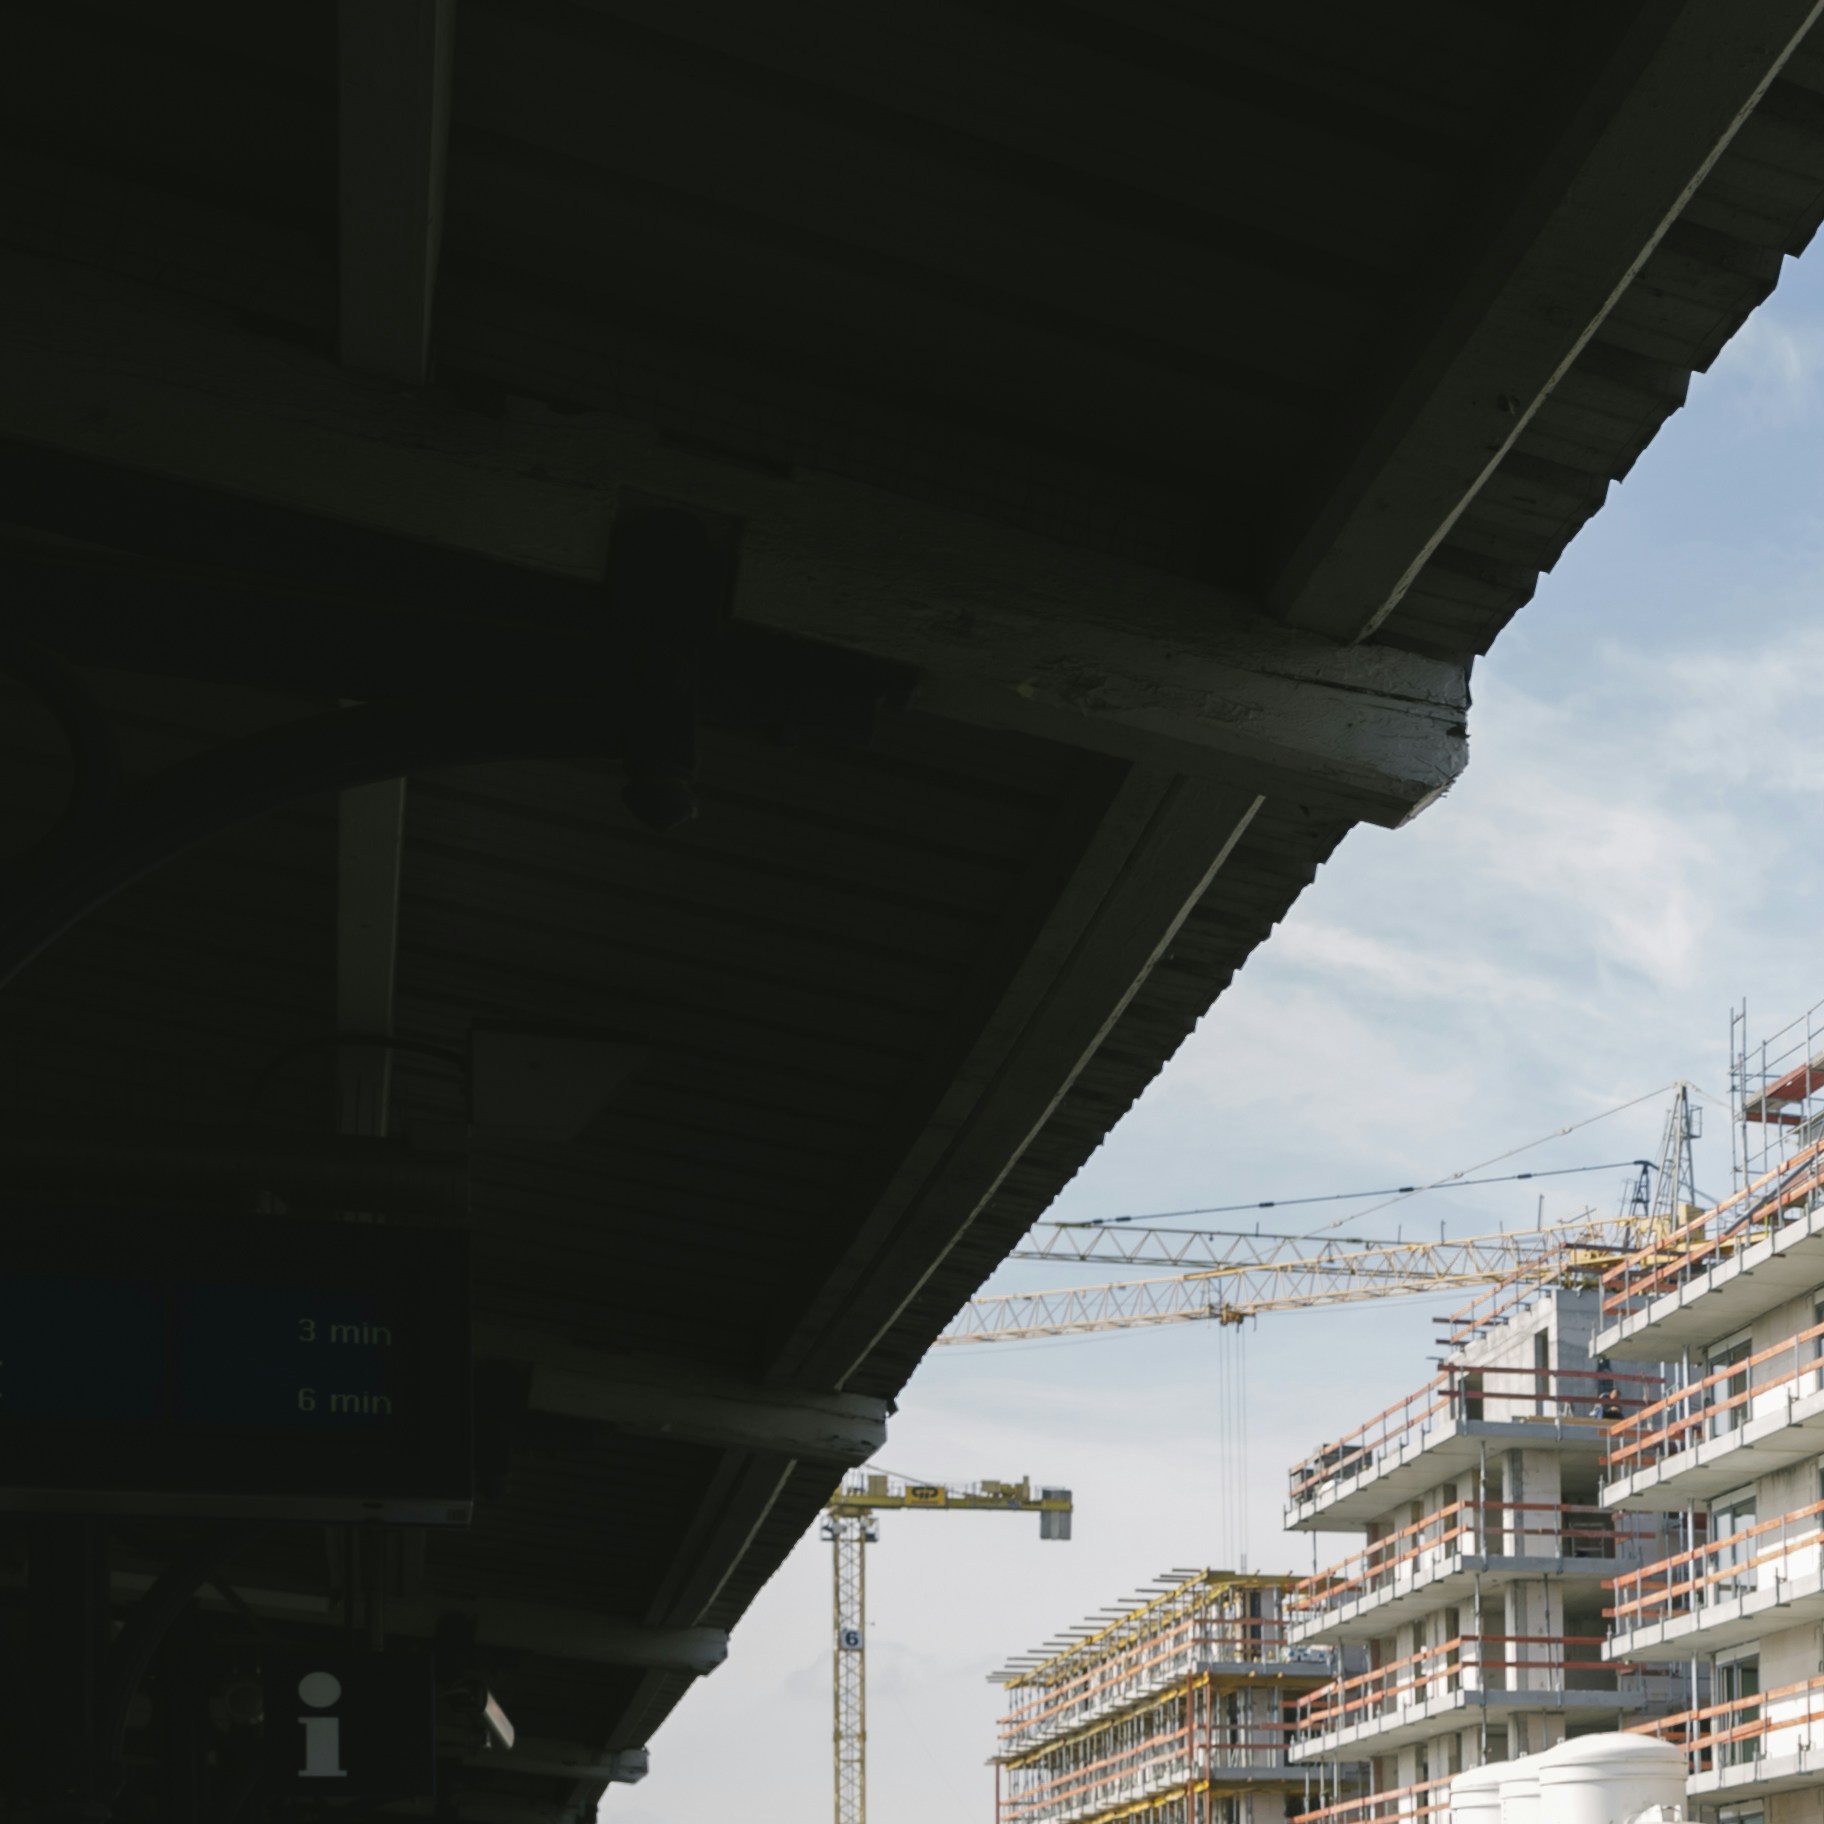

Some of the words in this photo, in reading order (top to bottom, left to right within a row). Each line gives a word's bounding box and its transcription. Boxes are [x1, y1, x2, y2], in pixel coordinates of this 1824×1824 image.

[297, 1318, 317, 1344] 3
[329, 1318, 393, 1347] min
[297, 1387, 317, 1413] 6
[329, 1386, 393, 1416] min
[844, 1631, 860, 1648] 6
